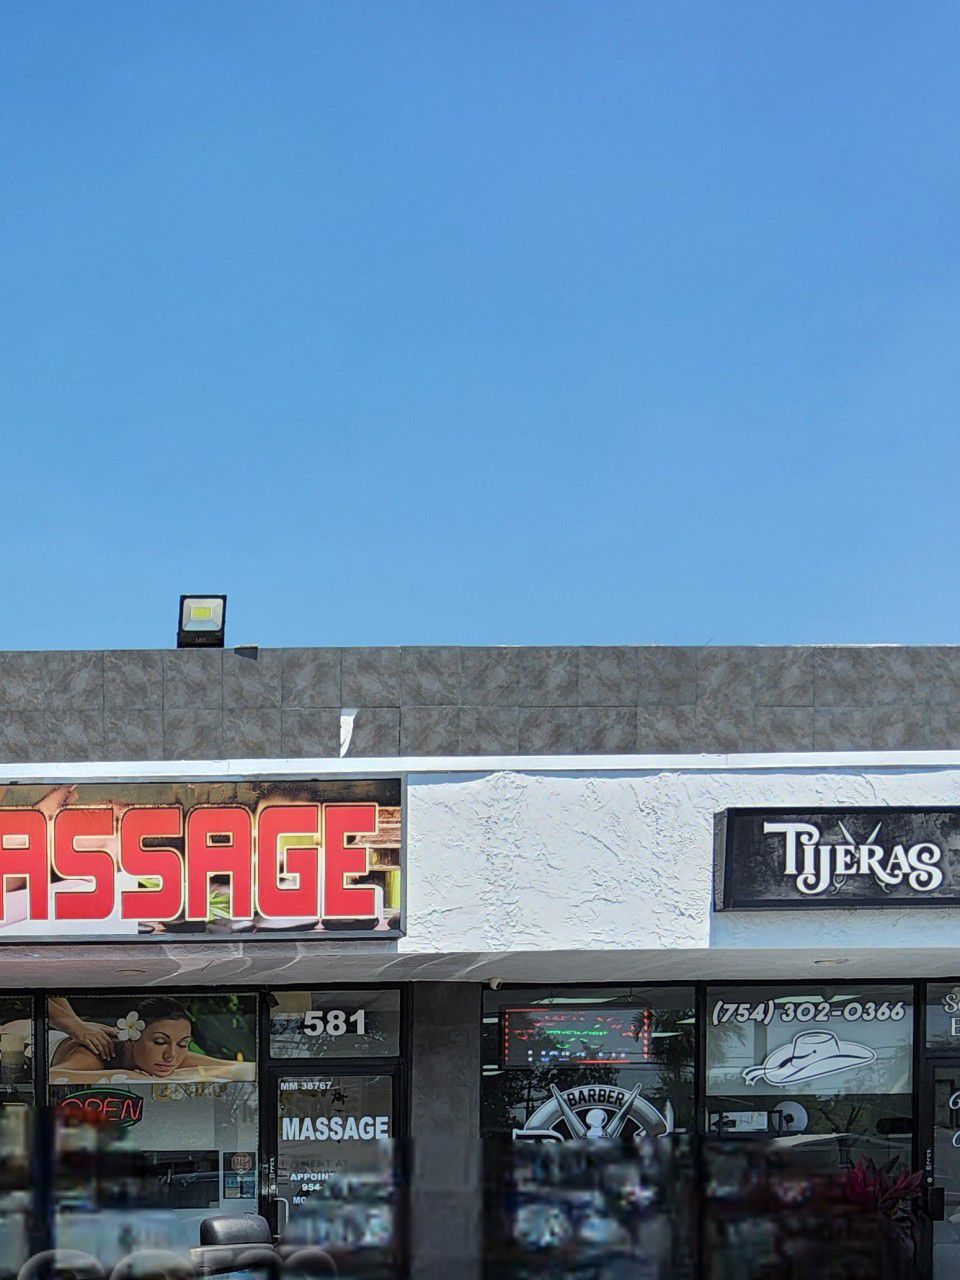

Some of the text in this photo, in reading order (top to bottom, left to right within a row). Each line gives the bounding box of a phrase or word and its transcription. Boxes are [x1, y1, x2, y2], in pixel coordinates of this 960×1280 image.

[763, 821, 943, 894] TIJERAS
[303, 1009, 366, 1036] 581
[713, 1000, 906, 1026] (754) 302-0366
[280, 1082, 332, 1090] MM 38767
[566, 1088, 626, 1108] BARBER
[282, 1116, 389, 1141] MASSAGE
